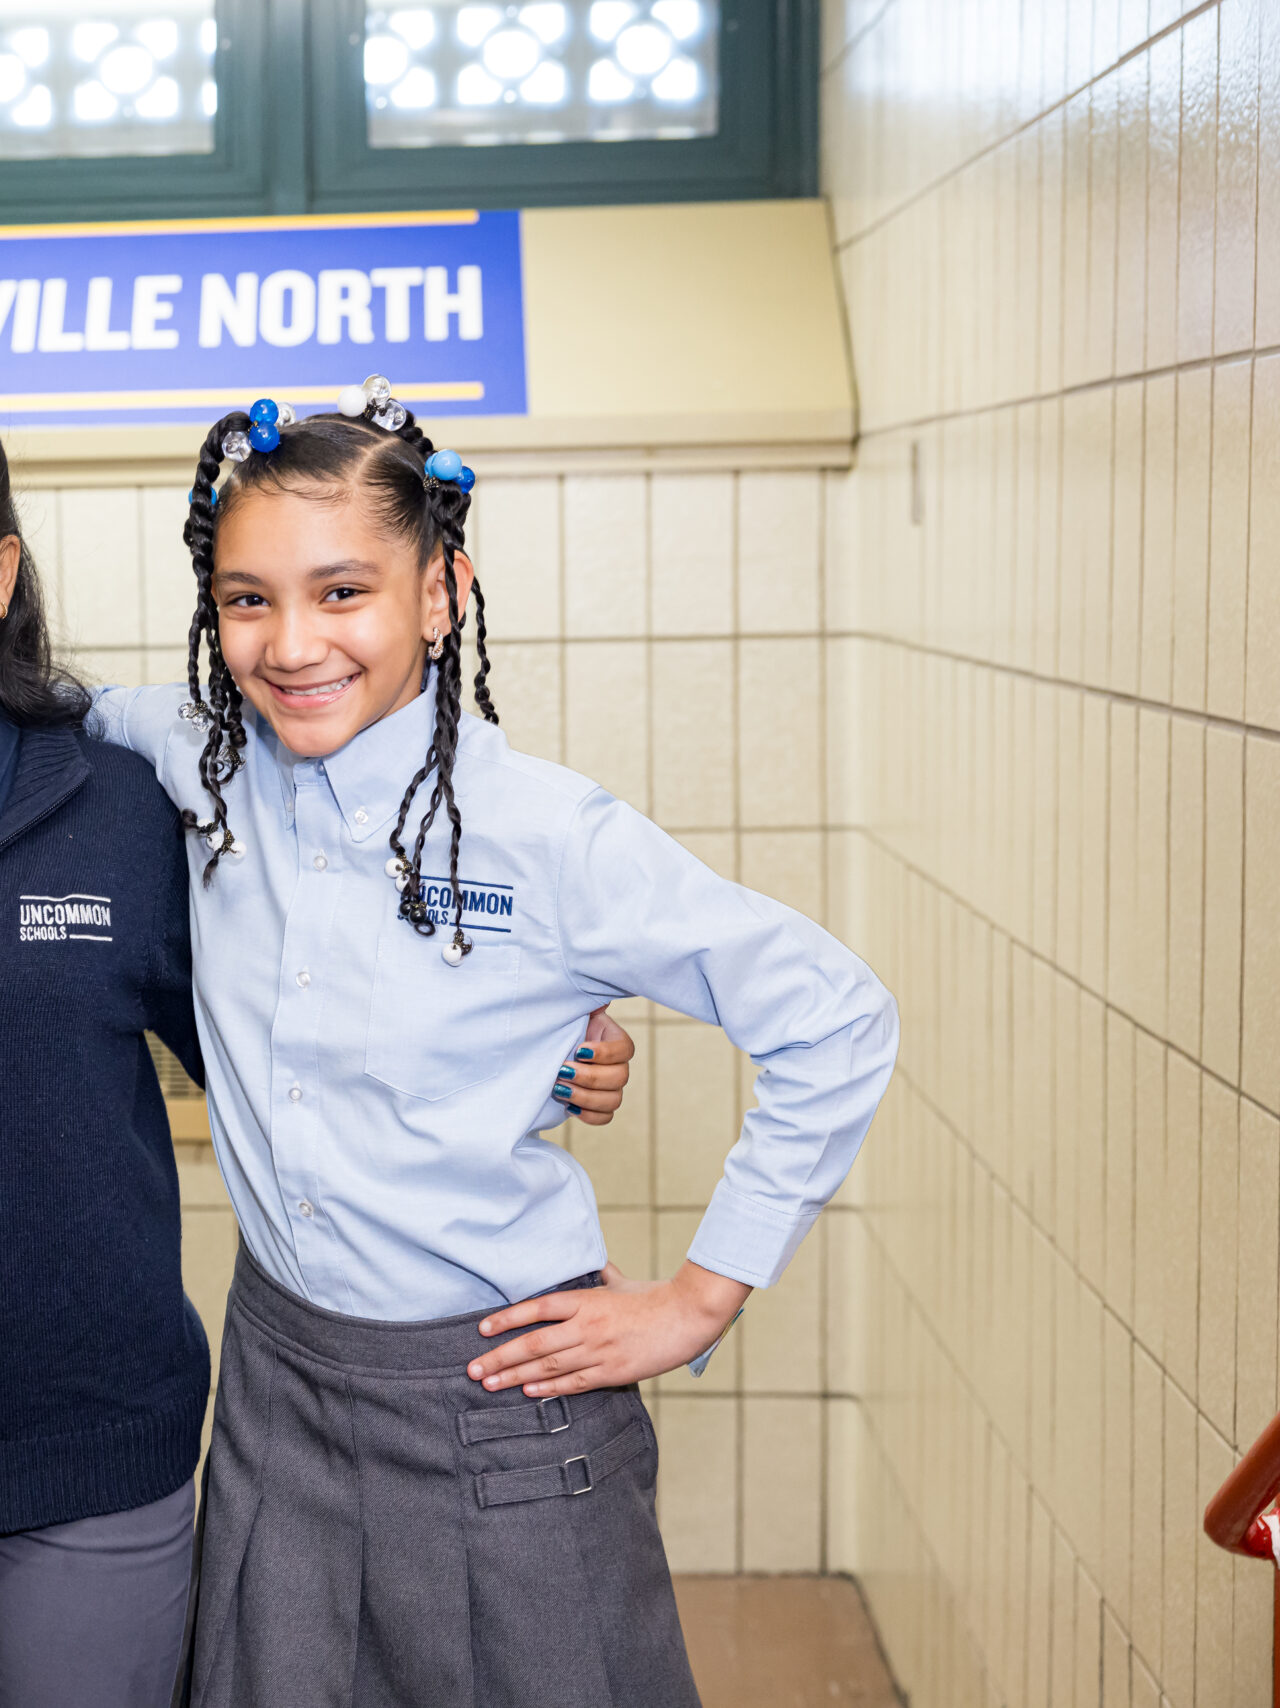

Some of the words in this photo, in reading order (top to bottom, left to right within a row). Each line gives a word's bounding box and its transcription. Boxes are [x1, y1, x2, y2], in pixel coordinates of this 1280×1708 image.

[198, 264, 484, 348] NORTH
[401, 884, 513, 916] COMMON
[20, 904, 111, 926] UNCOMMON
[20, 926, 67, 941] SCHOOLS
